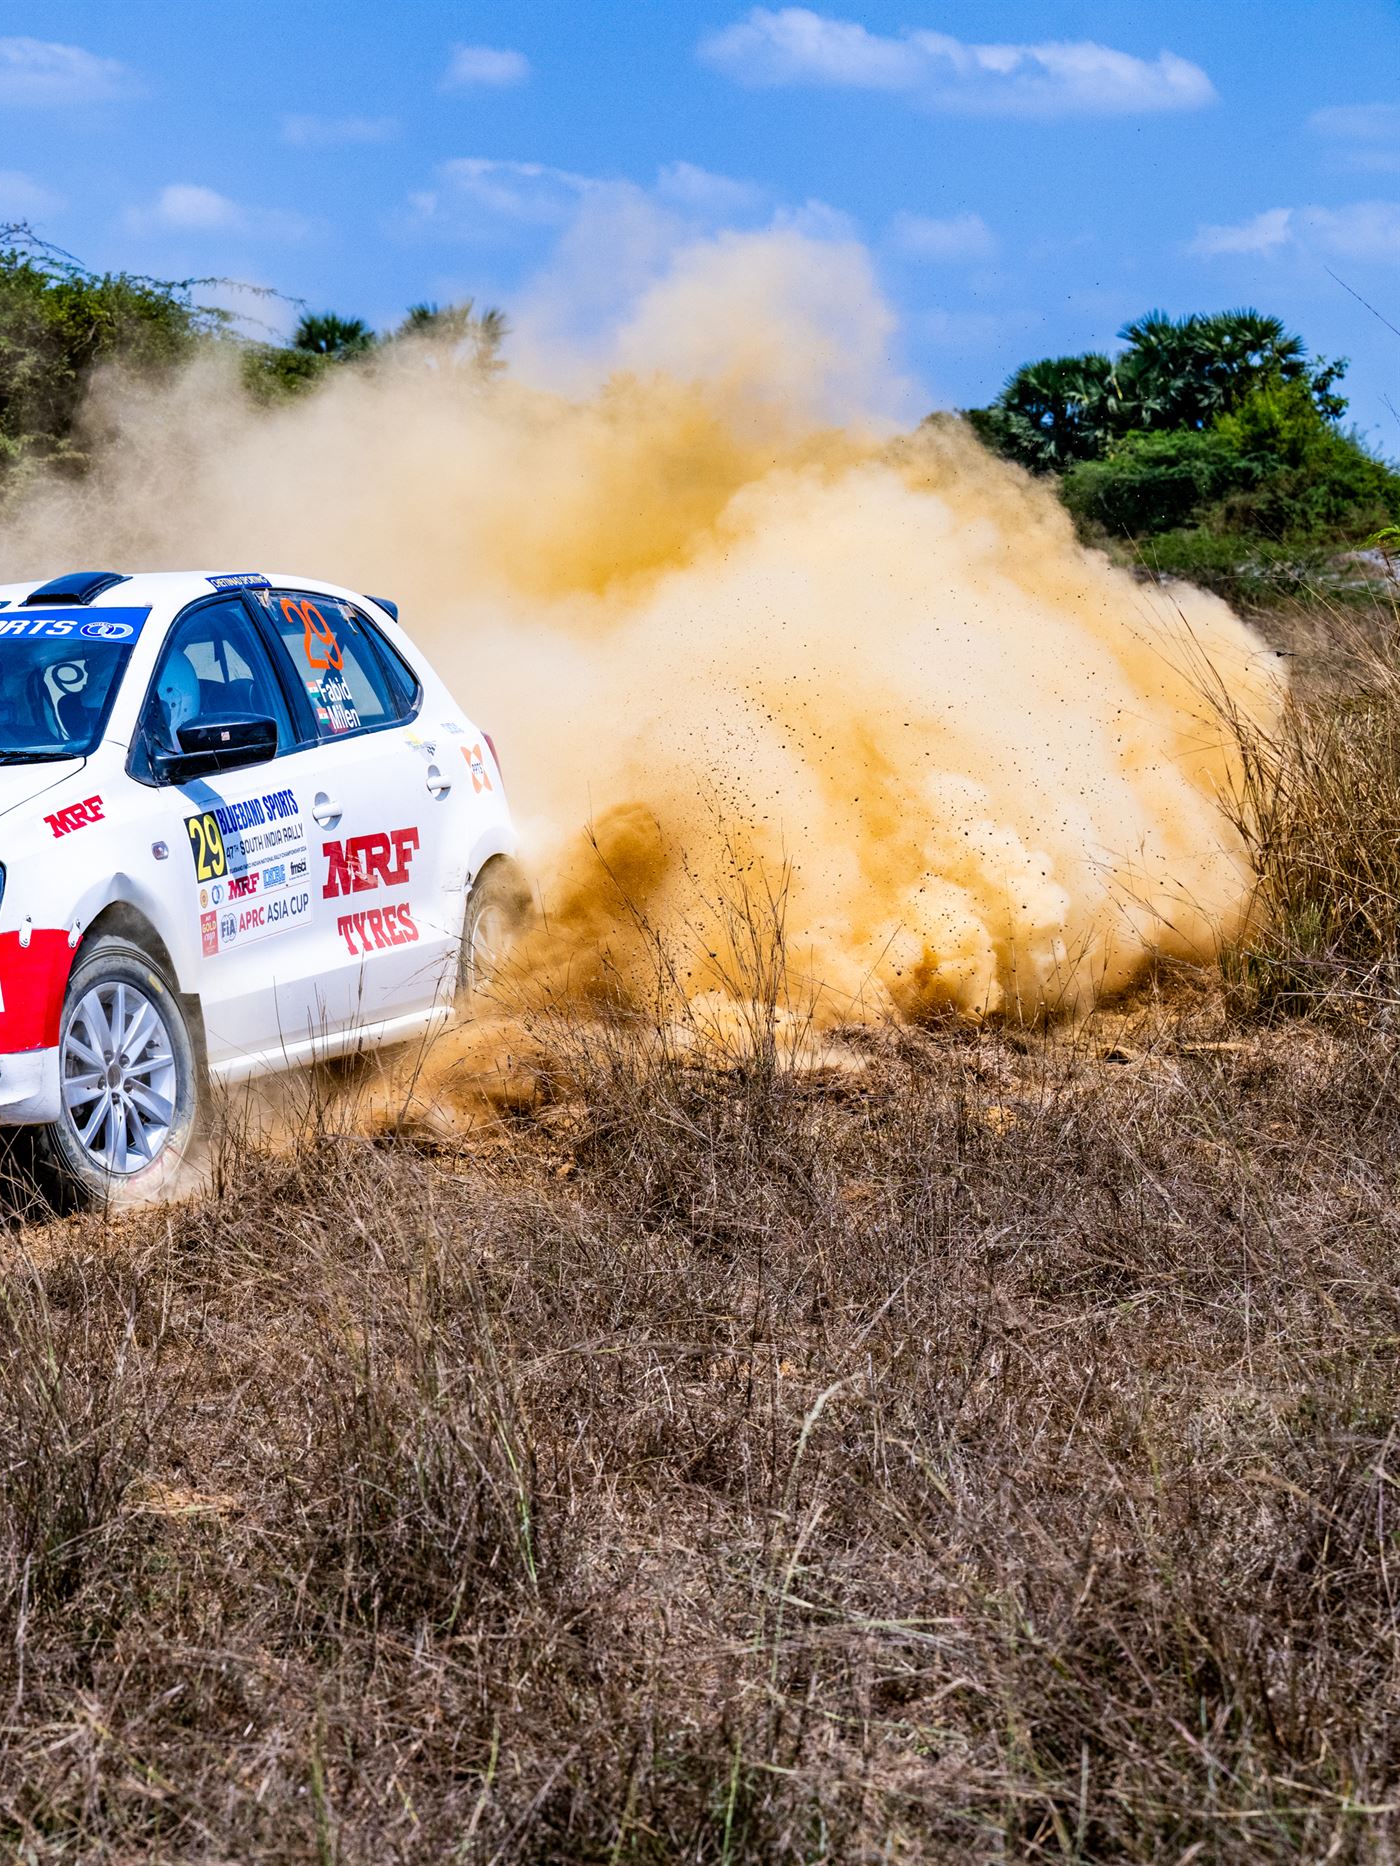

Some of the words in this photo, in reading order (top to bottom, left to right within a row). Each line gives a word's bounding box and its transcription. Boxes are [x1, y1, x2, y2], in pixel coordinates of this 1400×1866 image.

[280, 598, 344, 671] 29
[316, 677, 353, 703] Fabid
[327, 705, 361, 730] Milen
[43, 795, 106, 839] MRF
[215, 798, 266, 836] BLUEBAND
[262, 788, 299, 822] SPORTS
[188, 814, 225, 880] 29
[240, 836, 263, 856] SOUTH
[264, 830, 283, 848] INDIA
[283, 823, 304, 841] RALLY
[322, 826, 420, 900] MRF
[228, 872, 260, 901] MRF
[202, 920, 217, 934] GOLD
[239, 906, 265, 933] APRC
[267, 899, 289, 923] ASIA
[290, 892, 309, 916] CUP
[337, 902, 420, 956] TYRES
